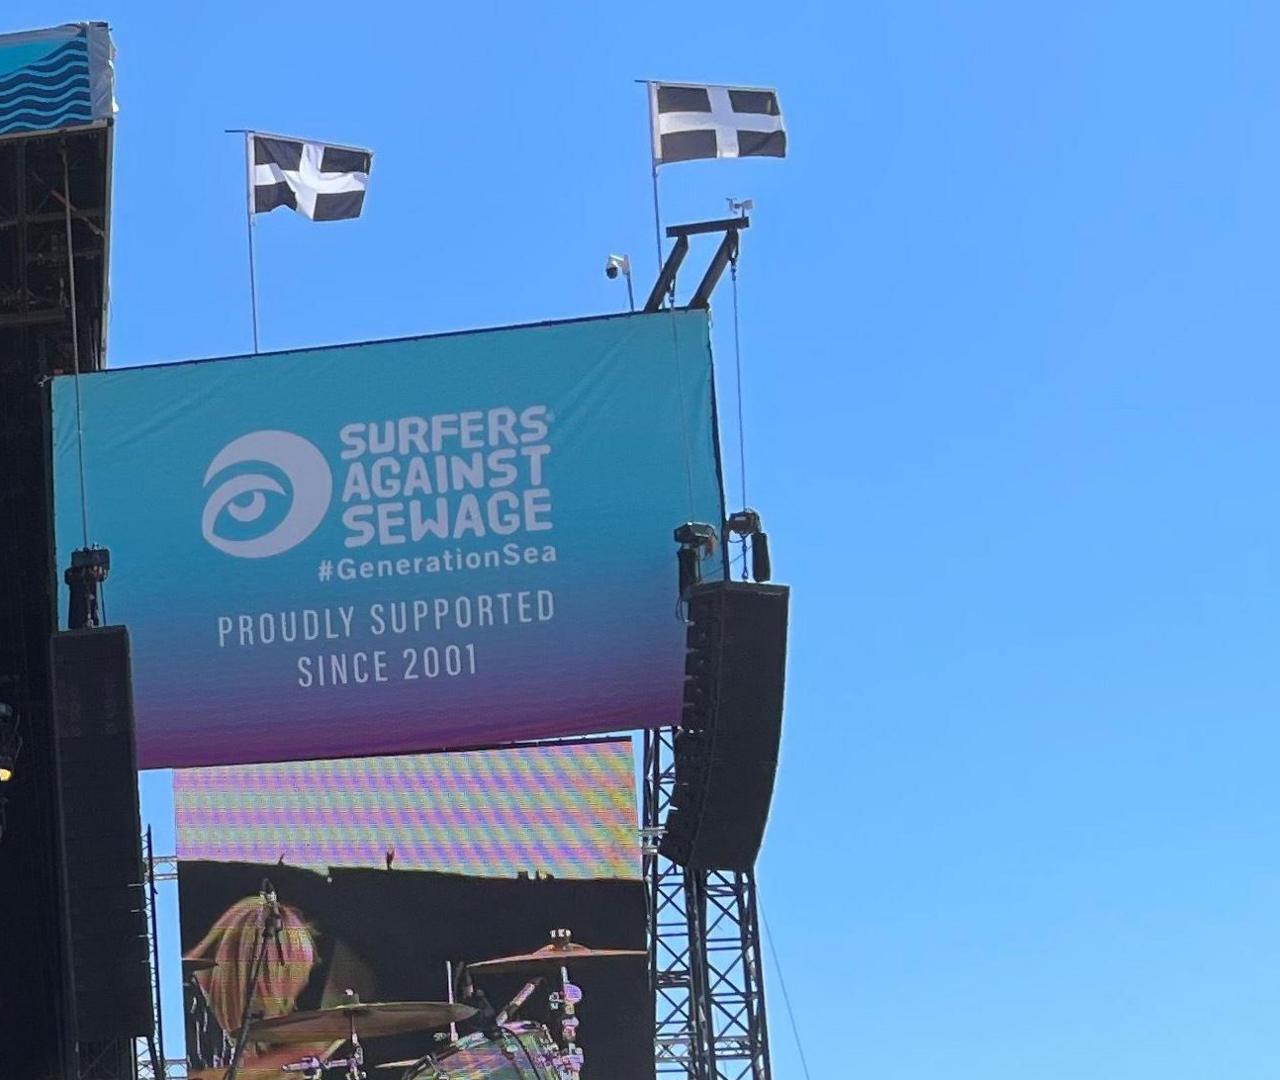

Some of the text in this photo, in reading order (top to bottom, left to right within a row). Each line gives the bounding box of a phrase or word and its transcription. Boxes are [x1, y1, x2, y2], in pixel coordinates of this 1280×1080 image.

[340, 404, 550, 460] SURFERS
[342, 446, 549, 502] AGAINST
[342, 489, 553, 548] SEWAGE
[319, 544, 557, 583] #GenerationSea
[218, 590, 554, 647] PROUDLY SUPPORTED
[297, 644, 478, 688] SINCE 2001
